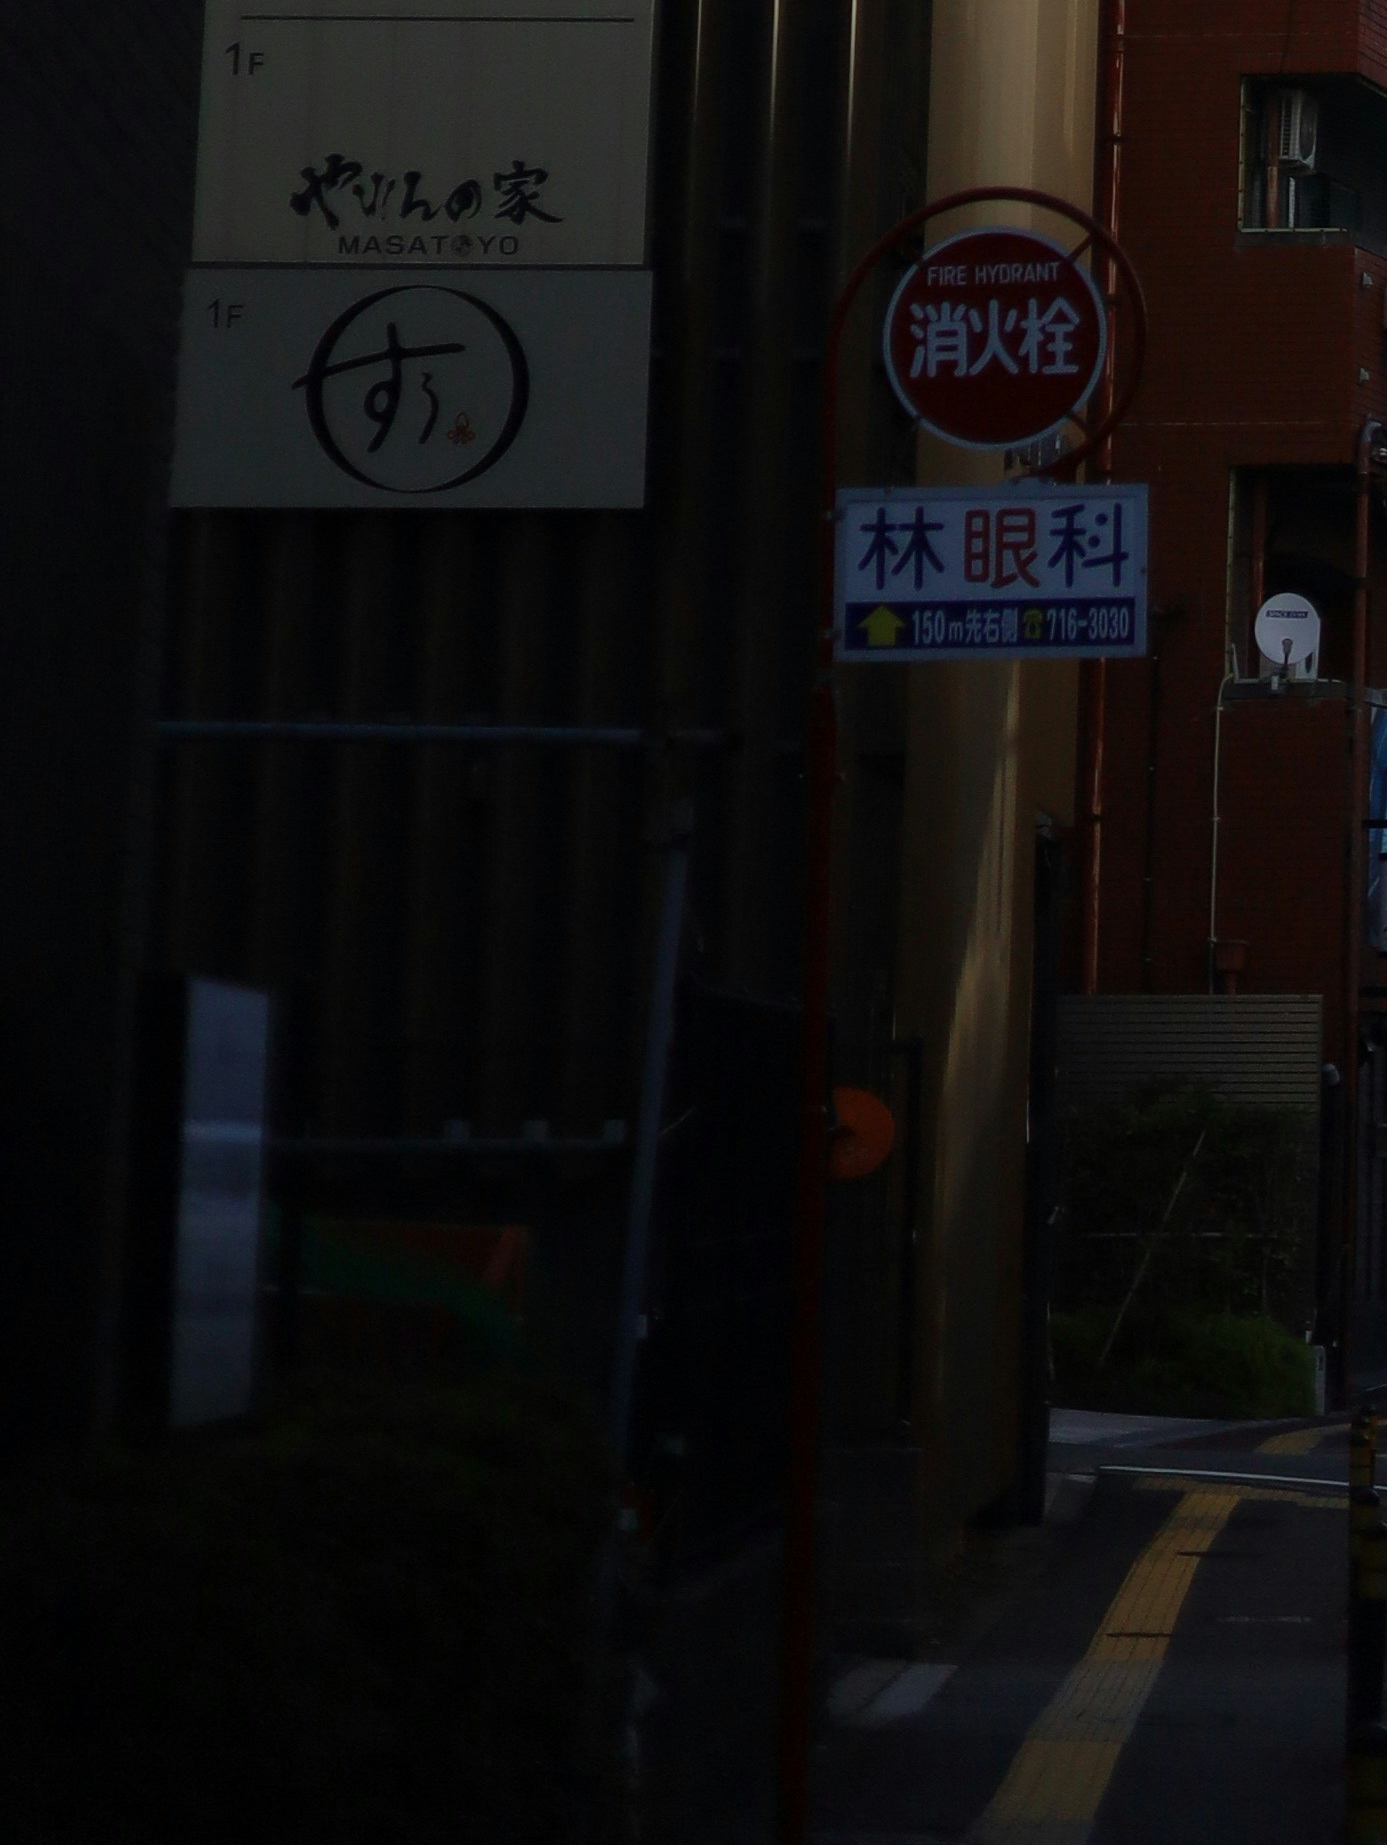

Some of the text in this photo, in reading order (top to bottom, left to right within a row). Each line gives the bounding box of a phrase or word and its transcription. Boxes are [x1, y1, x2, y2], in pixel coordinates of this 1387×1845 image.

[225, 43, 264, 75] 1F
[927, 260, 1061, 287] FIRE HYDRANT
[207, 299, 245, 328] 1F
[908, 296, 1080, 378] 消火栓
[858, 502, 1129, 590] 林眼科
[1047, 606, 1128, 641] 716-3030
